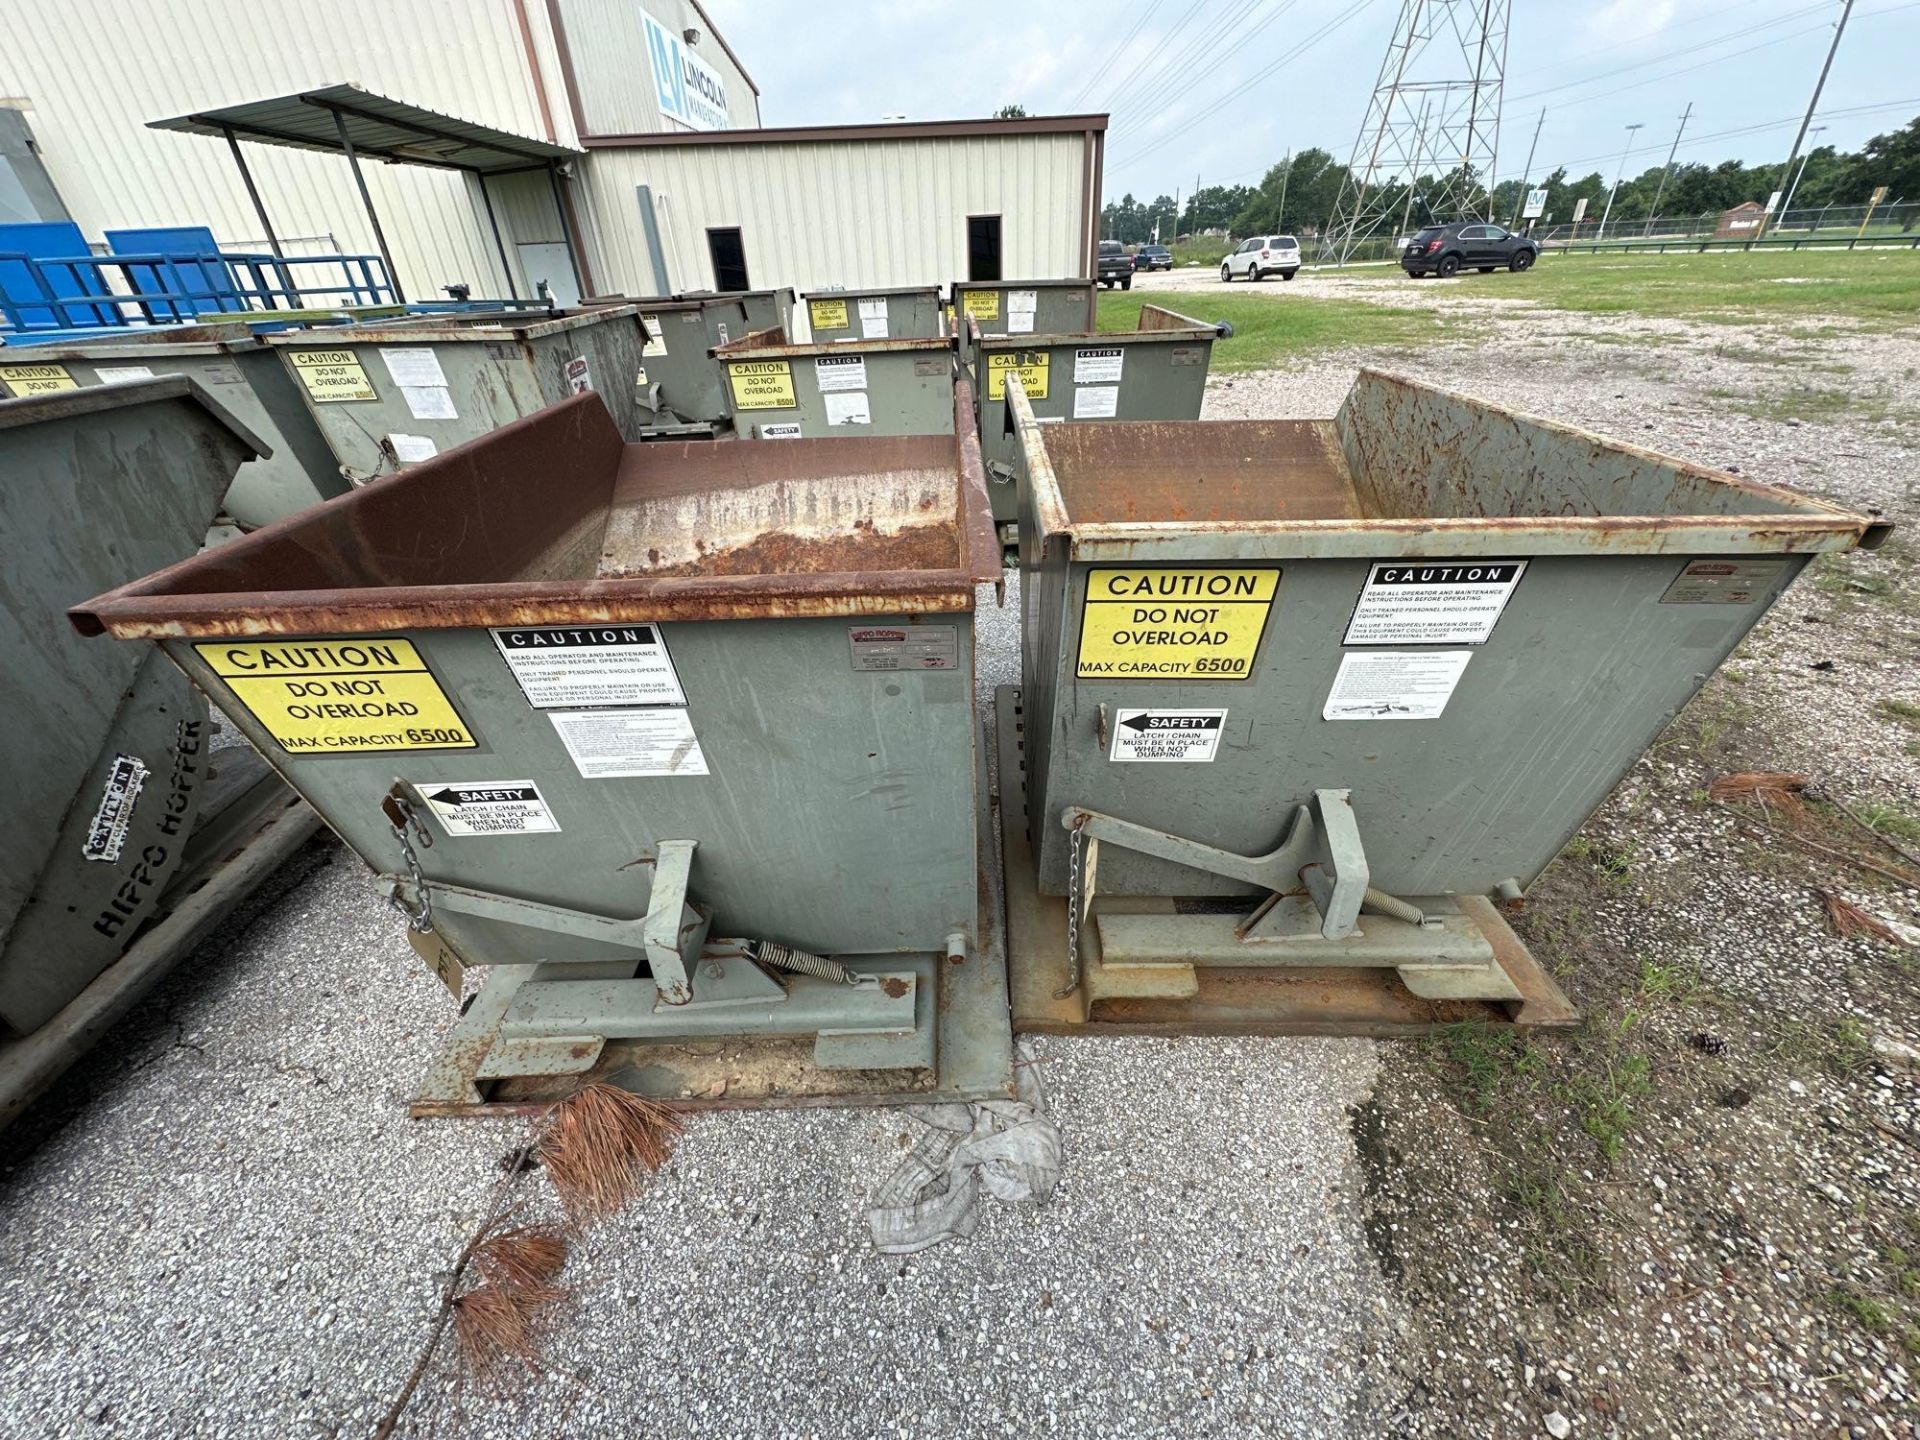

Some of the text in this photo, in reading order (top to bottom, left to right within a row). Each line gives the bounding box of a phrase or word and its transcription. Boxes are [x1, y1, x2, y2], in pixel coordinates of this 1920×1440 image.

[681, 56, 727, 112] LINCOLN
[1528, 192, 1545, 205] LM
[297, 352, 351, 364] CAUTION
[4, 367, 62, 378] CAUTION
[315, 368, 329, 376] DO
[735, 364, 783, 374] CAUTION
[26, 382, 41, 390] DO
[315, 378, 358, 386] OVERLOAD
[761, 377, 776, 385] NOT
[744, 387, 783, 395] OVERLOAD
[1384, 568, 1502, 582] CAUTION
[1108, 575, 1257, 595] CAUTION
[1133, 608, 1219, 624] DO NOT
[511, 630, 639, 646] CAUTION
[1113, 631, 1228, 645] OVERLOAD
[226, 645, 400, 670] CAUTION
[1080, 658, 1245, 672] MAX CAPACITY 6500
[285, 680, 386, 698] DO NOT
[287, 702, 419, 720] OVERLOAD
[1150, 718, 1210, 728] SAFETY
[279, 729, 464, 748] MAX CAPACITY 6500
[459, 789, 523, 802] SAFETY
[454, 805, 488, 813] LATCH
[508, 810, 542, 818] PLACE
[92, 719, 201, 938] HIPPO HOPPER
[105, 840, 116, 857] STAY
[113, 811, 128, 837] CLEAR
